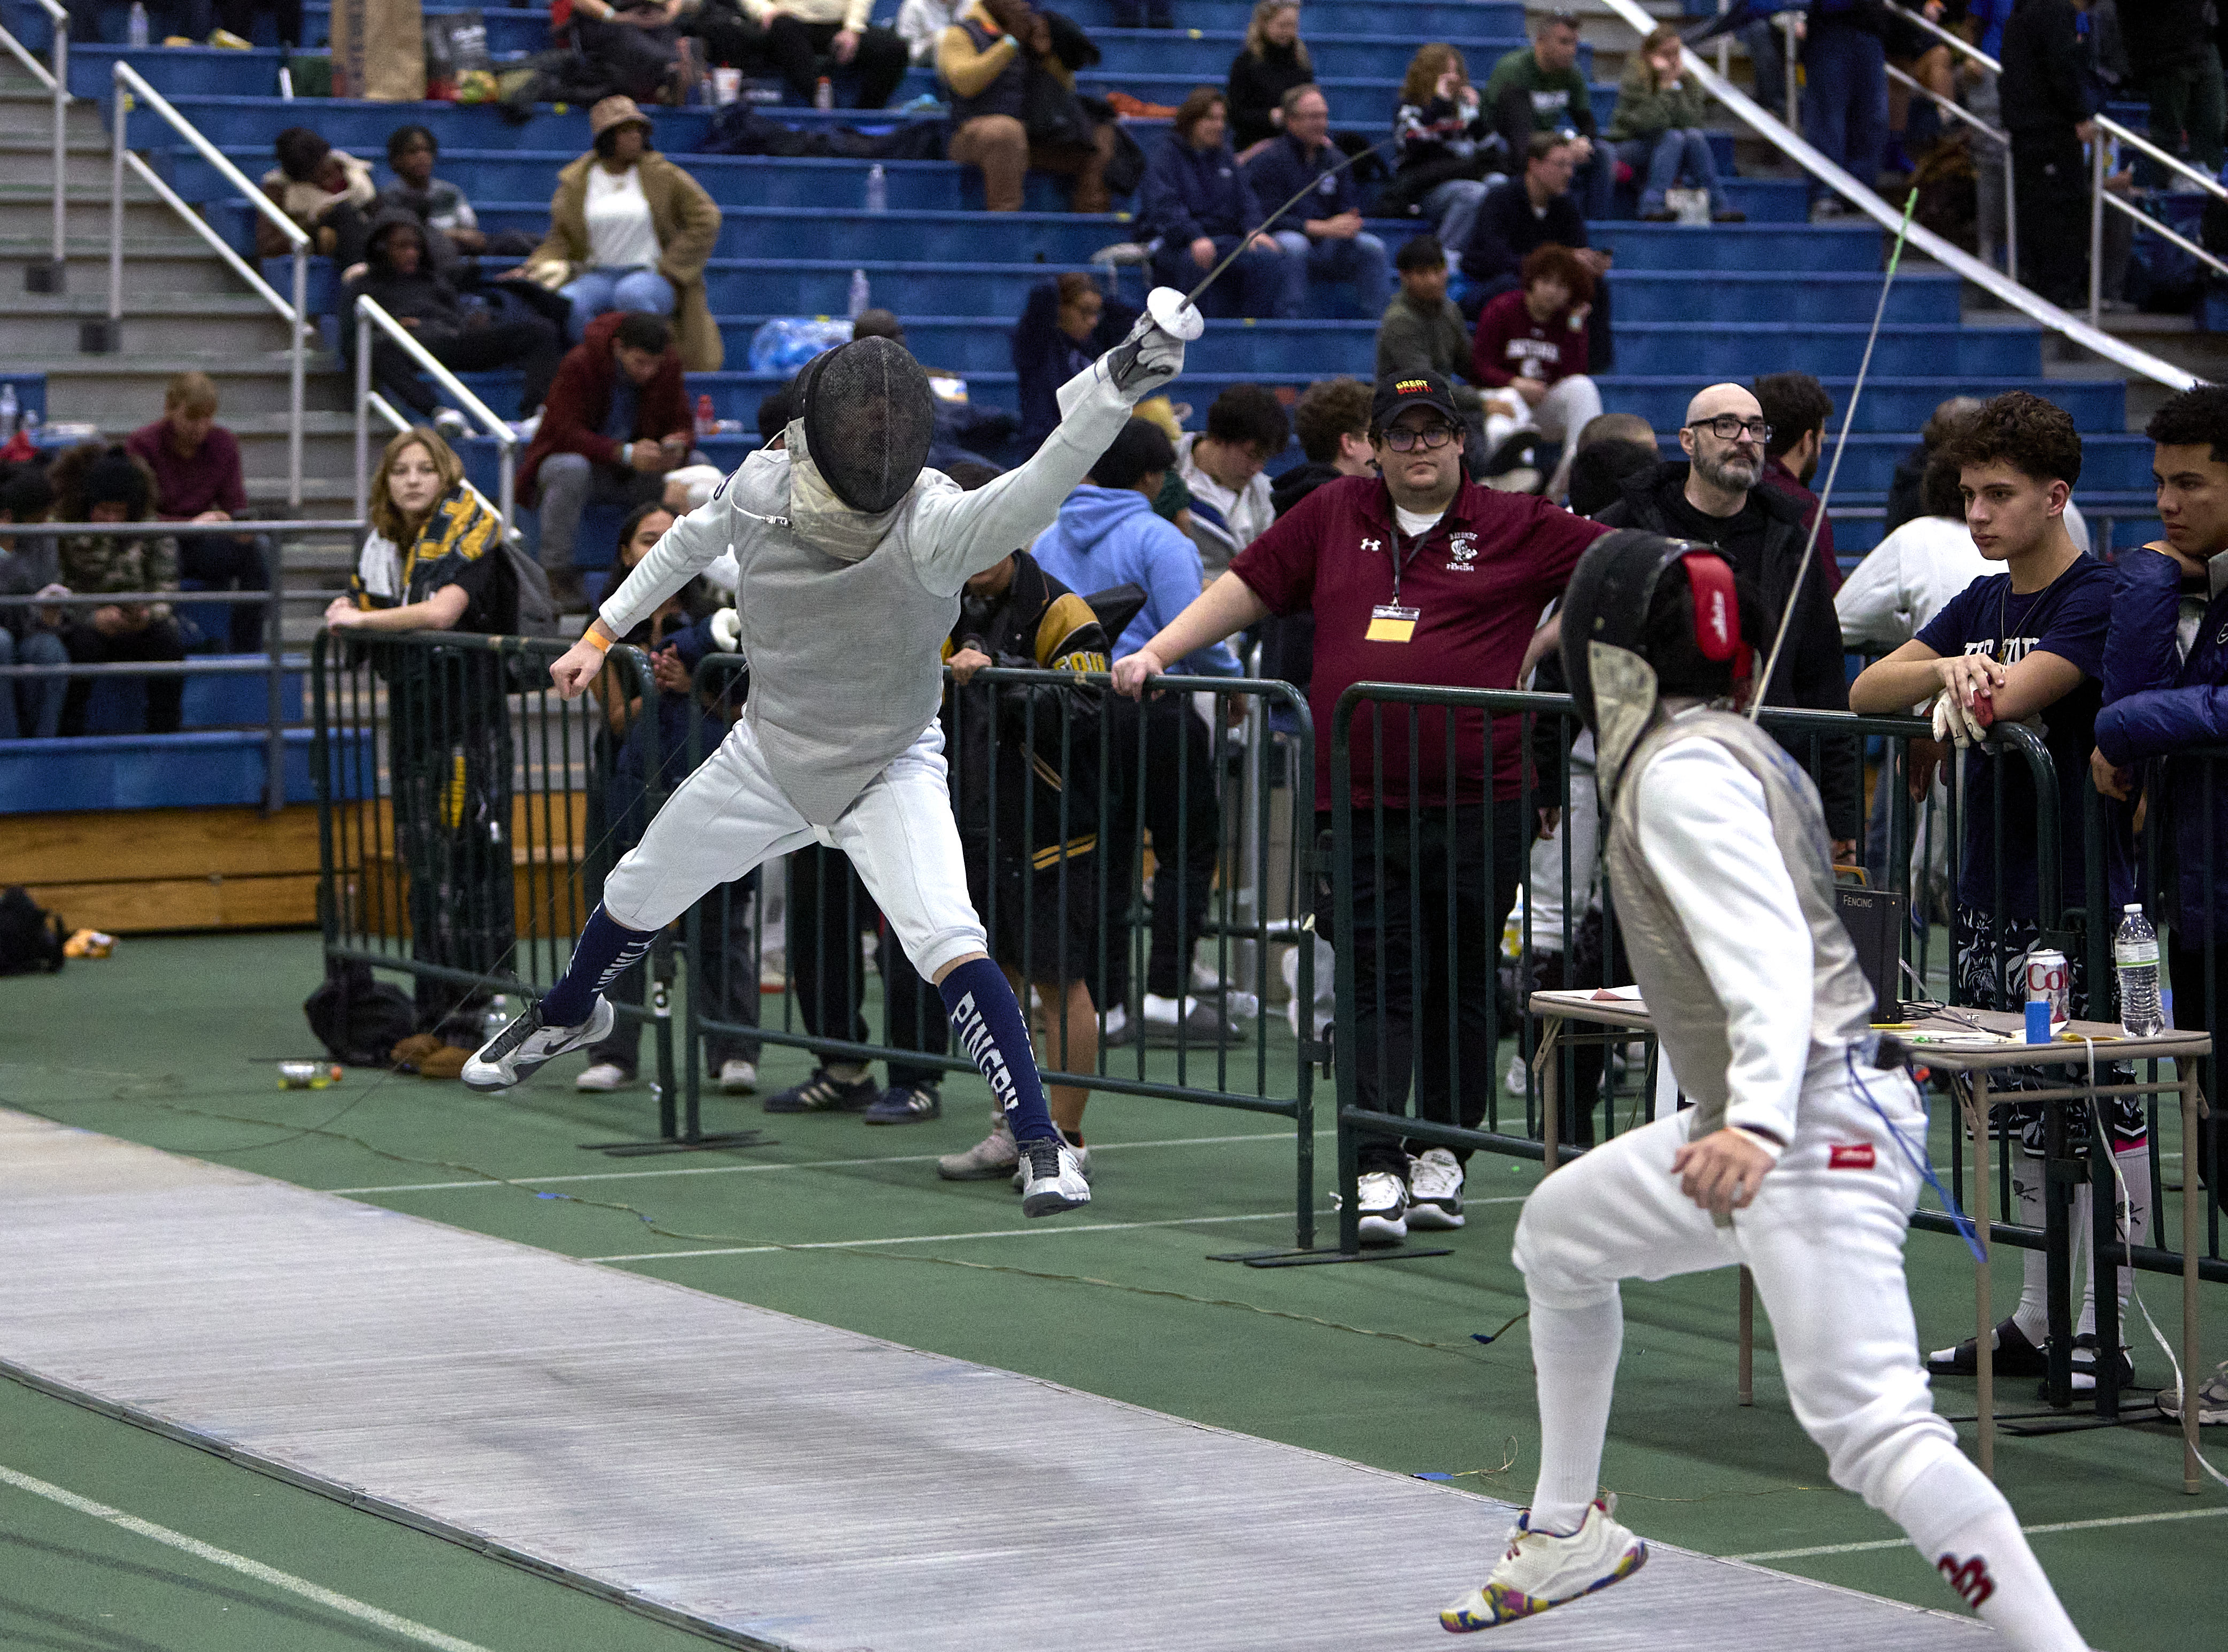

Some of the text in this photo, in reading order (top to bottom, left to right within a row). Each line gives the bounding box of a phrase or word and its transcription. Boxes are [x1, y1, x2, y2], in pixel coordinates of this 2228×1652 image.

[1396, 380, 1428, 389] GREAT
[1446, 562, 1475, 572] FENCING
[1843, 894, 1873, 908] FENCING
[951, 990, 1019, 1111] PINGRY
